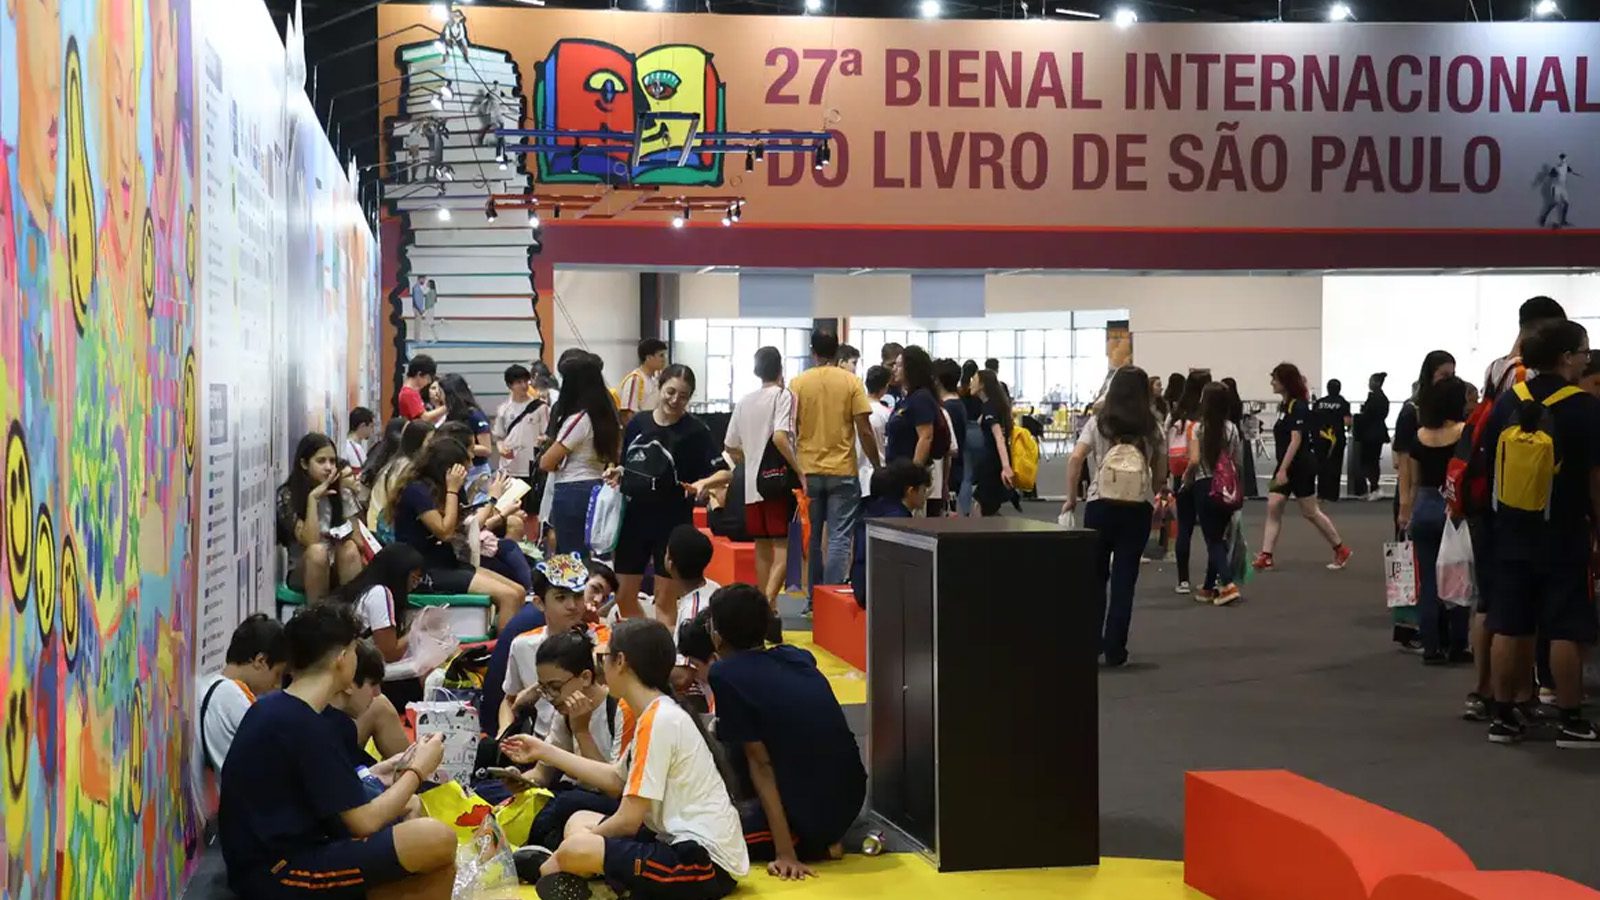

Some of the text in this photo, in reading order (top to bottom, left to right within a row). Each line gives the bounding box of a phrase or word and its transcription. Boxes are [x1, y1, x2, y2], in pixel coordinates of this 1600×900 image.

[764, 48, 1600, 113] 27ª BIENAL INTERNACIONAL
[767, 121, 1500, 194] DO LIVRO DE SÃO PAULO
[1318, 402, 1342, 410] STAFF
